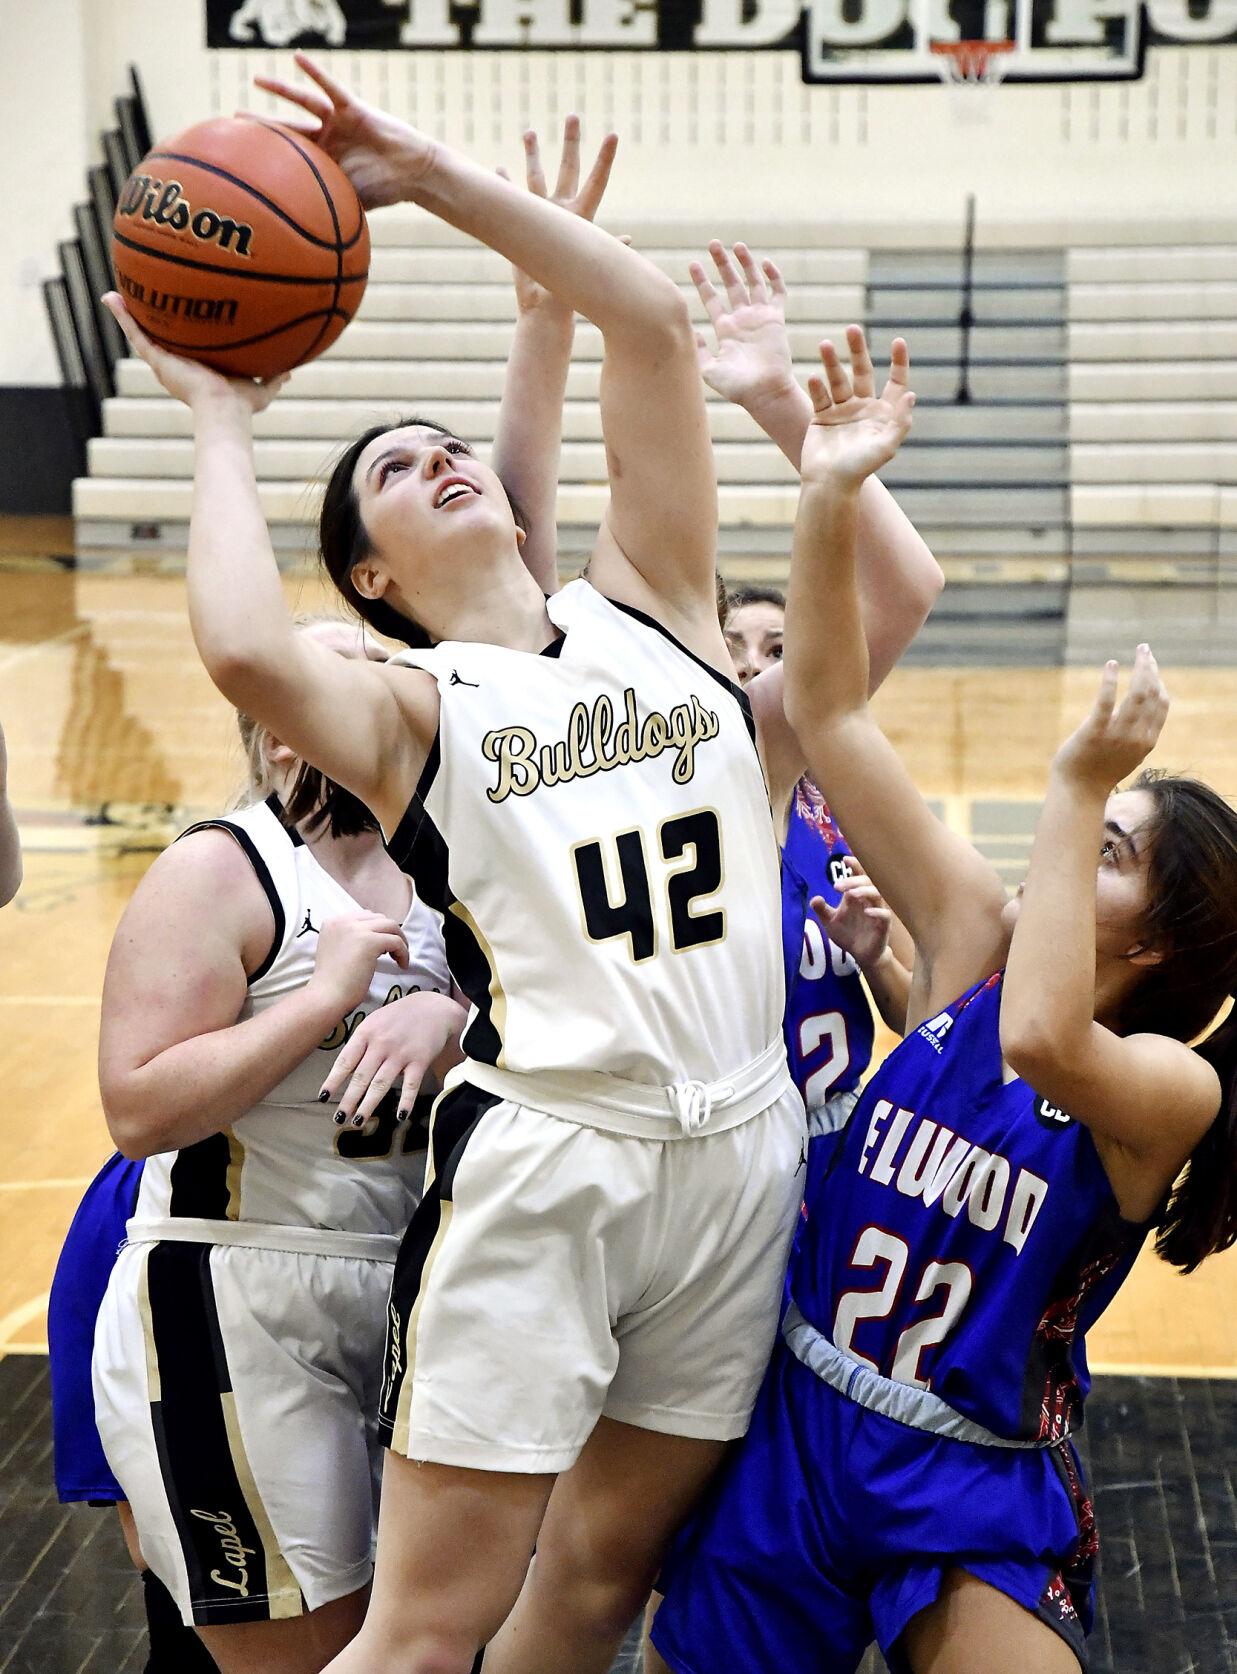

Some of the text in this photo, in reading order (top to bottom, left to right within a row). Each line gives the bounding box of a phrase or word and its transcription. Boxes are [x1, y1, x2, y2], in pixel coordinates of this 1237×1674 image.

[482, 687, 719, 803] Bulldogs
[569, 805, 728, 966] 42
[857, 1098, 1049, 1258] ELWOOD
[832, 1226, 972, 1391] 22
[190, 1508, 257, 1597] Lapel
